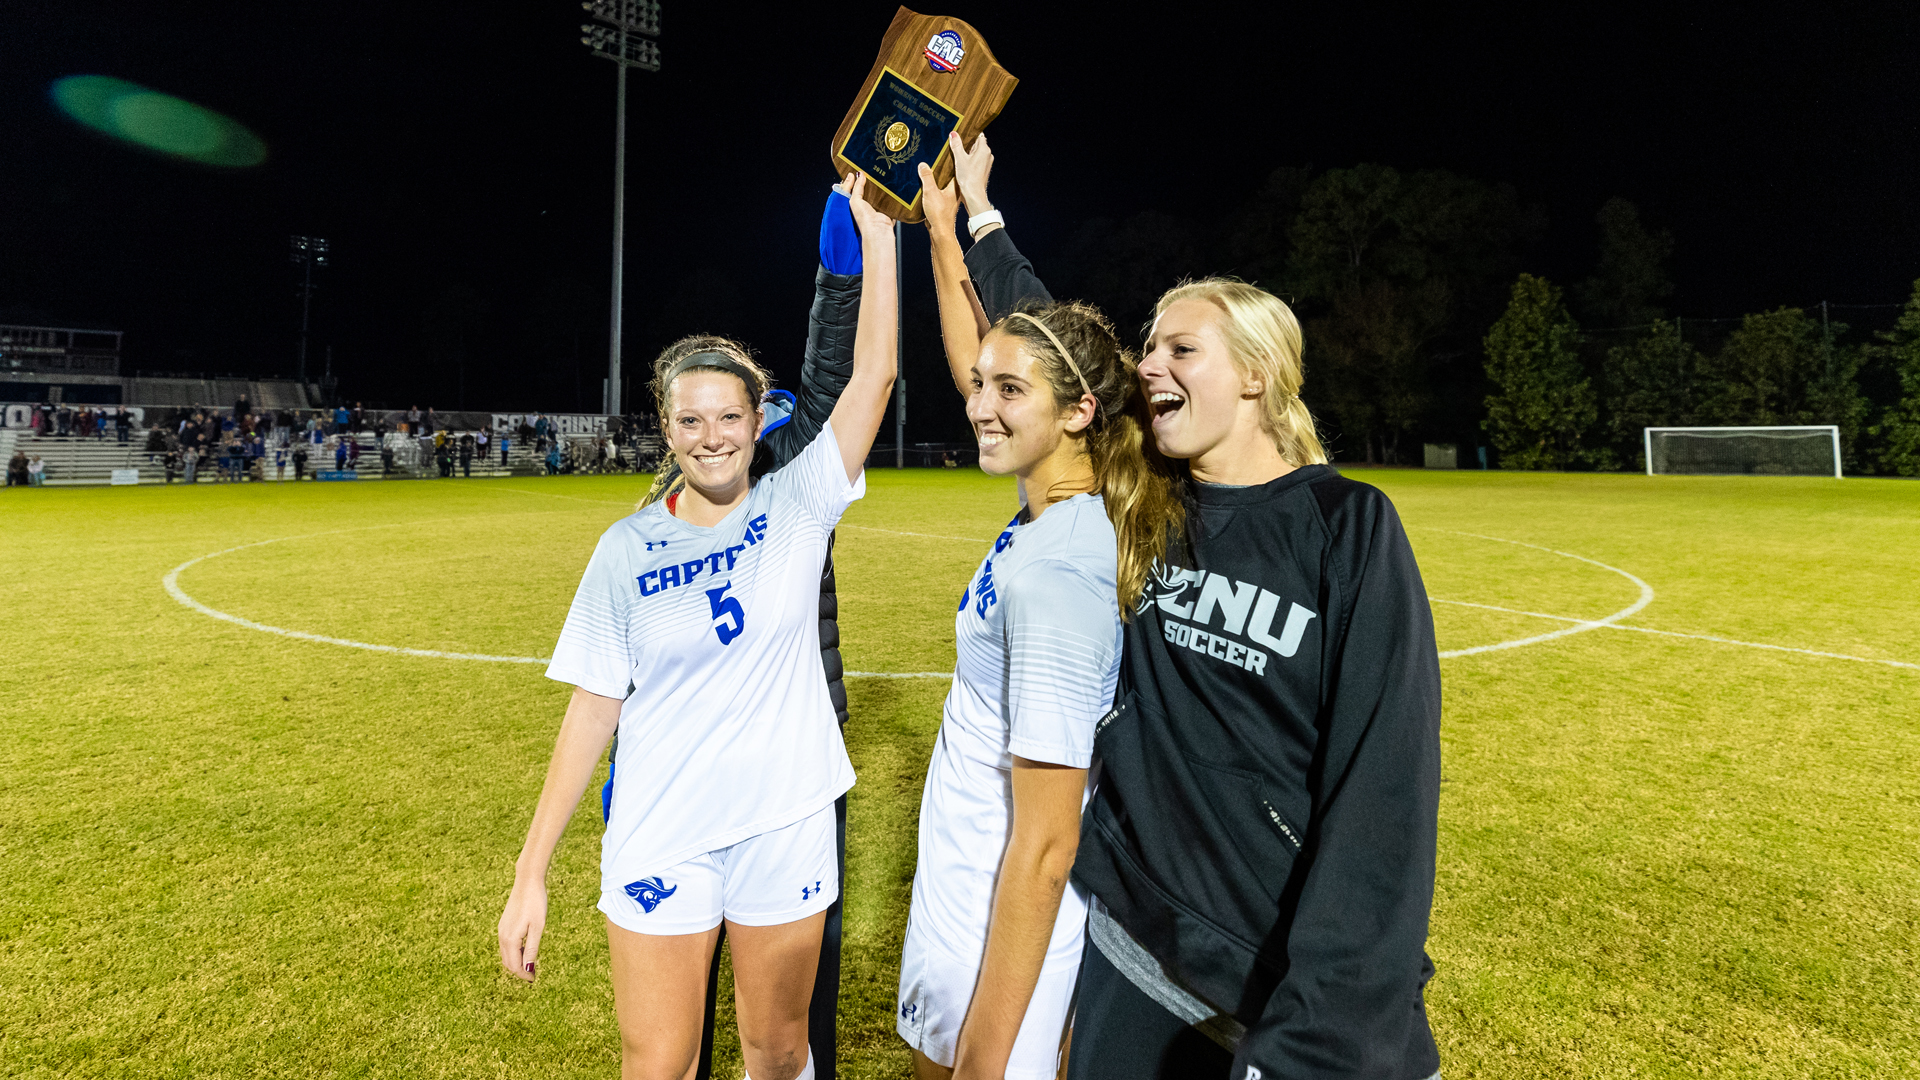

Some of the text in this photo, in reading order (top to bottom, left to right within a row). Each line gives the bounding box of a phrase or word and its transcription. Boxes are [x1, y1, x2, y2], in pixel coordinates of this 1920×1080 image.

[927, 34, 965, 65] CAC
[892, 99, 930, 127] CHAMPION
[918, 101, 946, 123] SOCCER
[872, 164, 886, 177] 2018
[705, 580, 746, 646] 5
[1157, 565, 1317, 658] CNU
[1164, 619, 1268, 677] SOCCER
